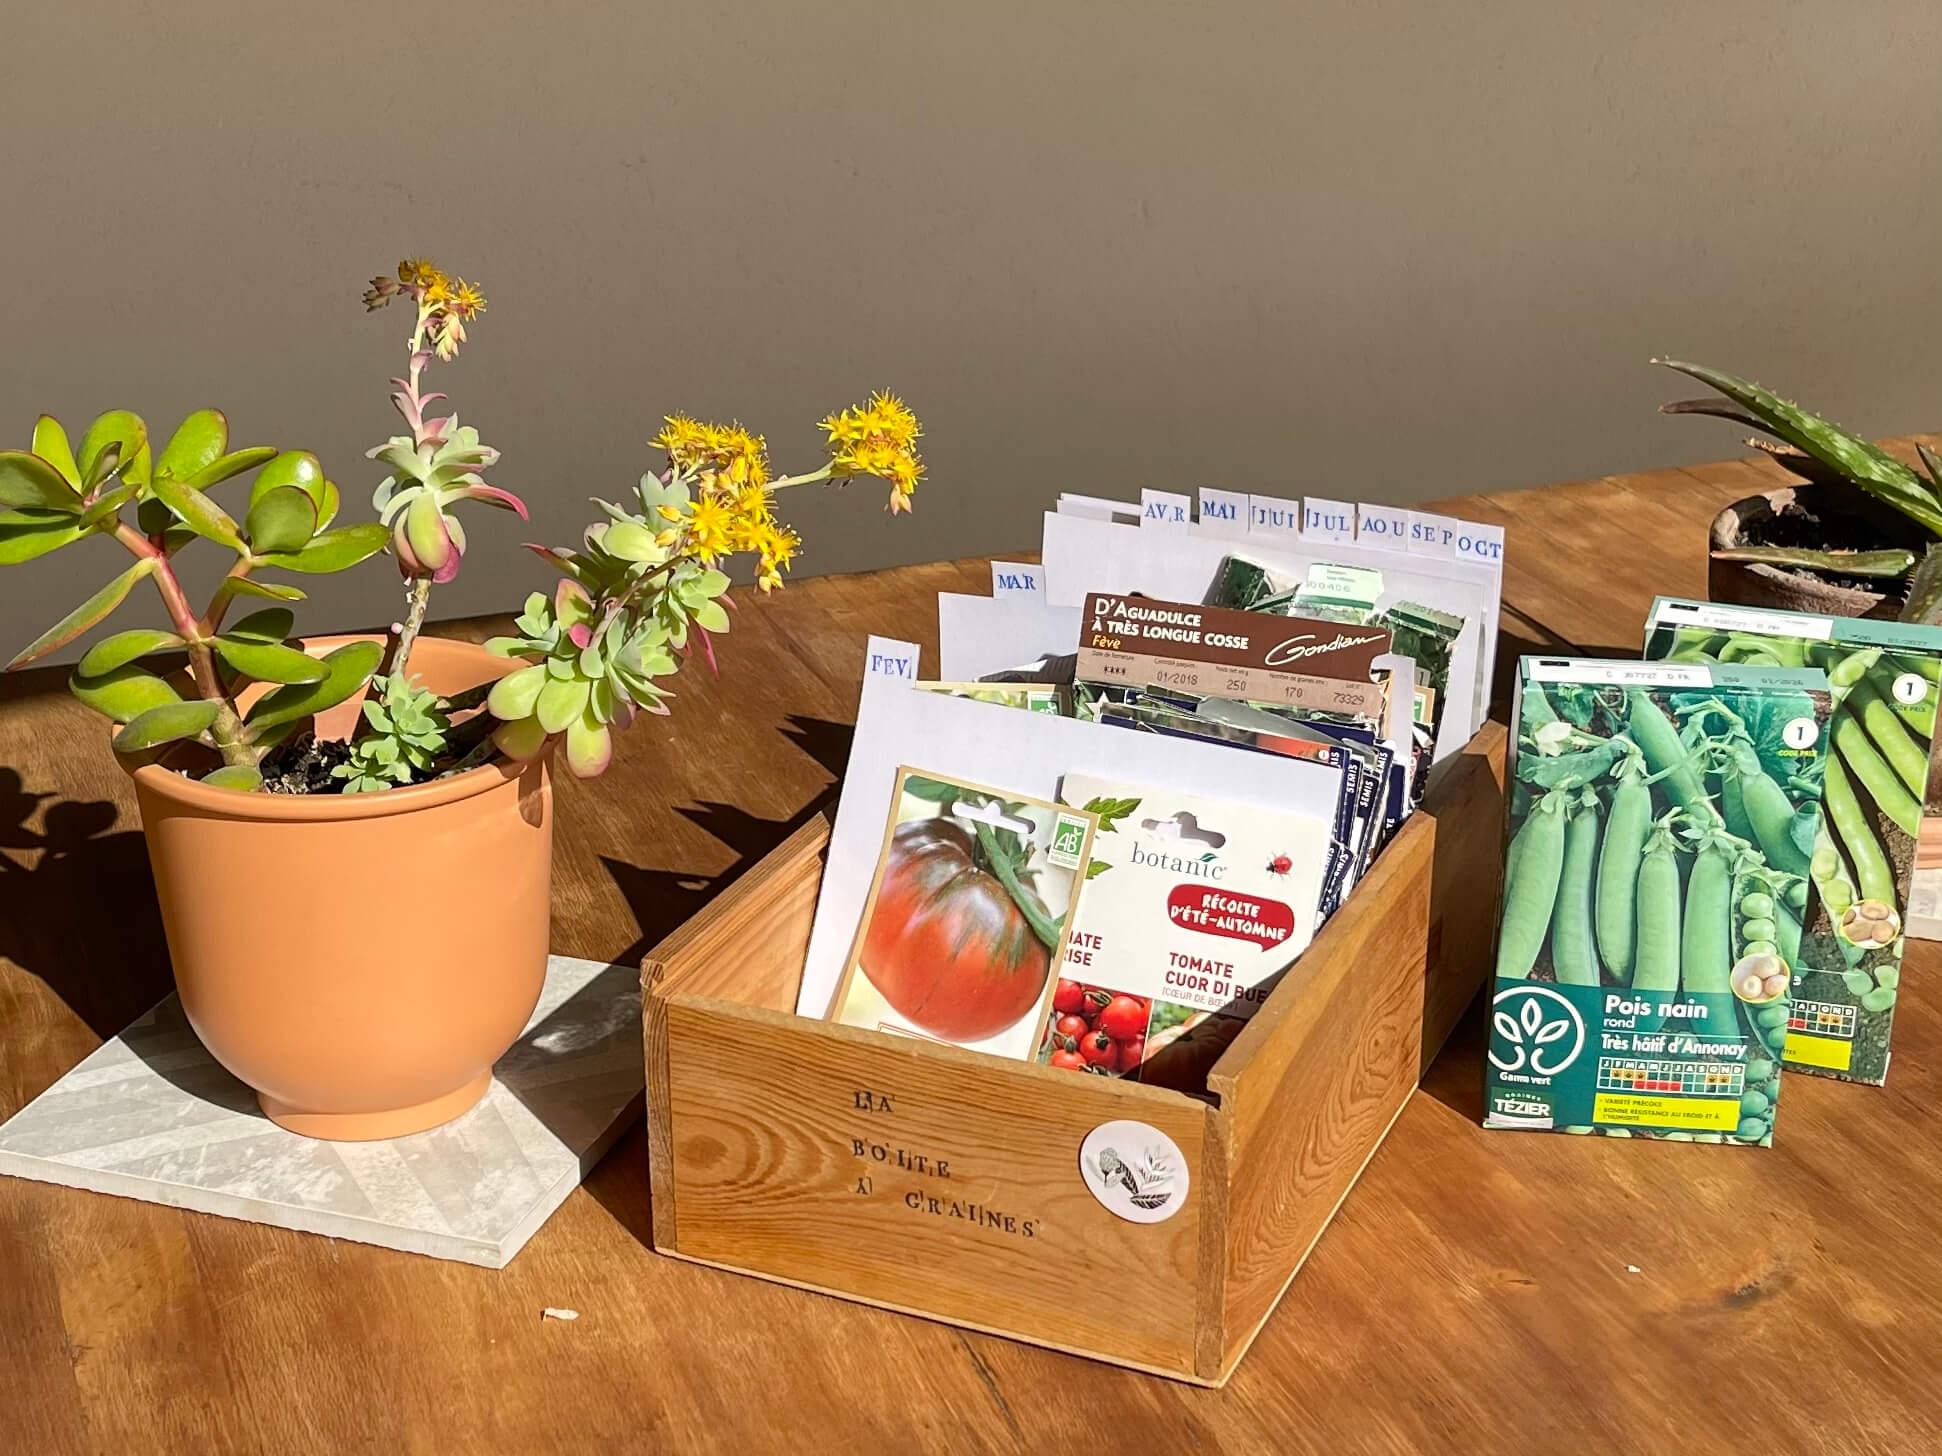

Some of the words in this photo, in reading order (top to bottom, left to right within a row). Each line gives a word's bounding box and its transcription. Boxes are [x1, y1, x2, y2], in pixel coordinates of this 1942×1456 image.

[1145, 503, 1185, 523] AVR
[1203, 501, 1237, 521] MAI
[1258, 508, 1295, 529] JUI
[1312, 511, 1350, 532] JUL
[1362, 517, 1405, 537] AOU
[1411, 523, 1453, 545] SEP
[1458, 536, 1501, 558] OCT
[998, 573, 1036, 591] MAR
[1091, 616, 1103, 633] À
[1107, 619, 1140, 637] TRÈS
[1143, 627, 1200, 645] LONGUE
[1204, 631, 1250, 650] COSSE
[1092, 634, 1121, 650] Fève
[871, 654, 909, 677] FEV
[1156, 672, 1199, 685] 01/2018
[1226, 679, 1247, 692] 250
[1906, 682, 1913, 696] 1
[1285, 686, 1303, 698] 170
[1797, 726, 1804, 740] 1
[1346, 763, 1358, 794] SEMIS
[1360, 780, 1374, 807] SEMIS
[1055, 832, 1078, 853] AB
[1130, 841, 1225, 880] botanic
[1202, 894, 1261, 918] RÉCOLTE
[1169, 952, 1234, 979] TOMATE
[1165, 970, 1209, 993] CUOR
[1213, 980, 1230, 996] DI
[1234, 984, 1267, 1003] BUE
[1605, 994, 1652, 1016] Pois
[1658, 998, 1708, 1019] nain
[1603, 1016, 1636, 1029] rond
[1600, 1033, 1629, 1050] Très
[1632, 1034, 1666, 1053] hâtif
[1667, 1036, 1748, 1060] d'Annonay
[854, 1090, 894, 1113] LA
[1494, 1098, 1551, 1117] TÉZIER
[852, 1139, 950, 1178] BOITE
[905, 1191, 1034, 1237] GRAINES
